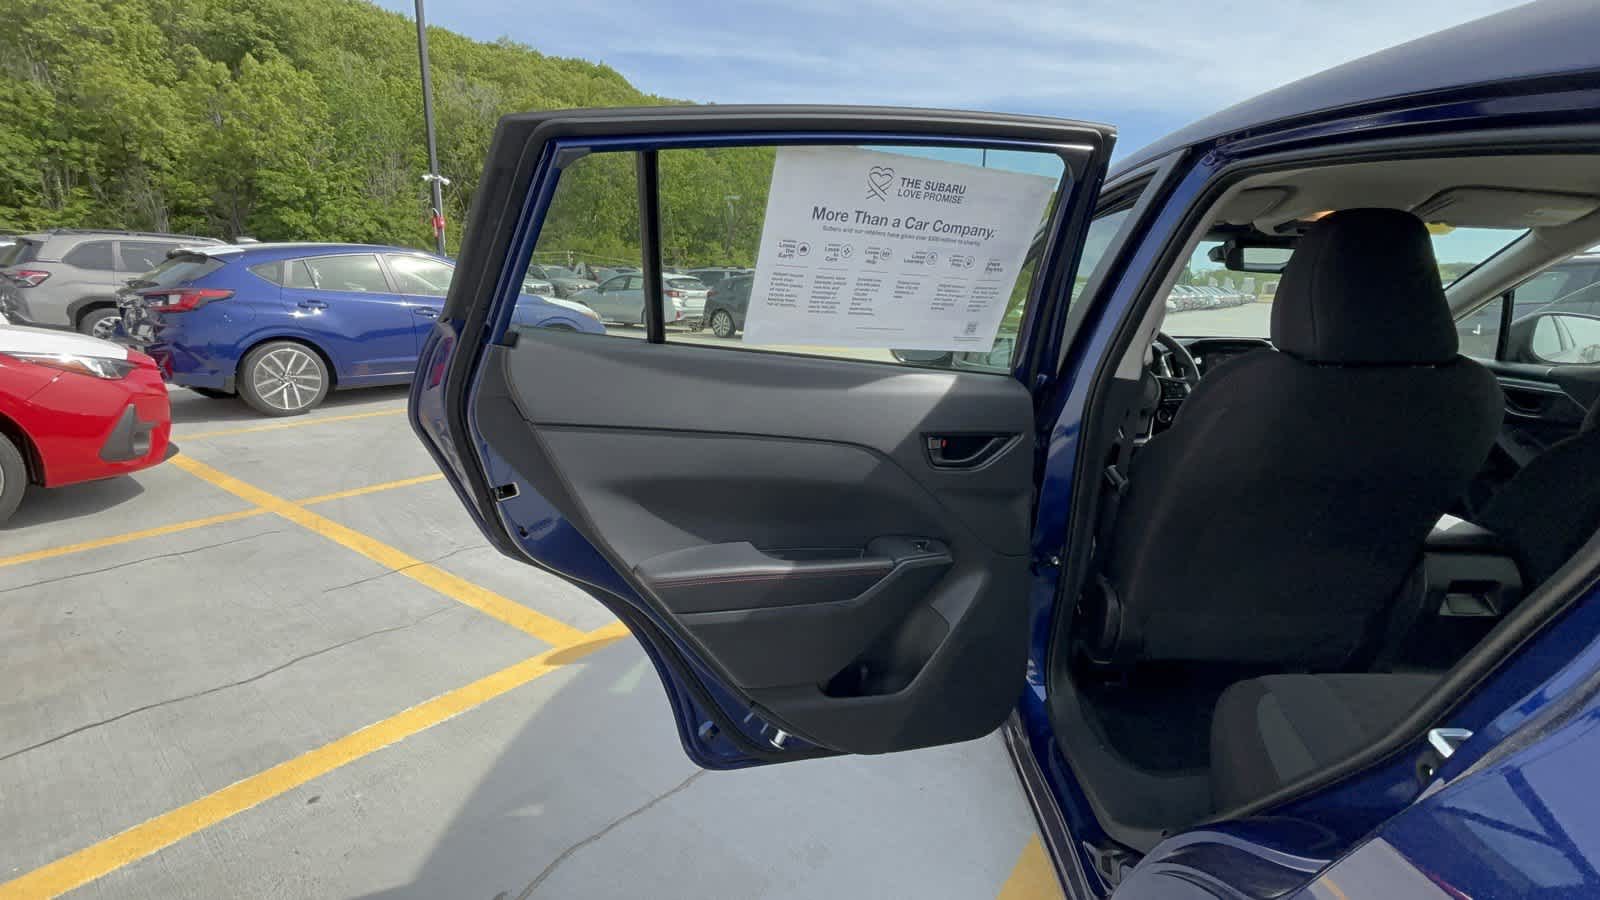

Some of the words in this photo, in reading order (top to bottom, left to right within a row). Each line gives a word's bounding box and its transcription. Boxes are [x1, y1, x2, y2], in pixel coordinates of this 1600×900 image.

[900, 177, 922, 190] THE
[924, 180, 967, 195] SUBARU
[897, 188, 922, 200] LOVE
[923, 191, 964, 205] PROMISE
[812, 206, 849, 222] More
[854, 210, 888, 227] Than
[892, 217, 901, 228] a
[904, 216, 930, 231] Car
[932, 219, 995, 240] Company.
